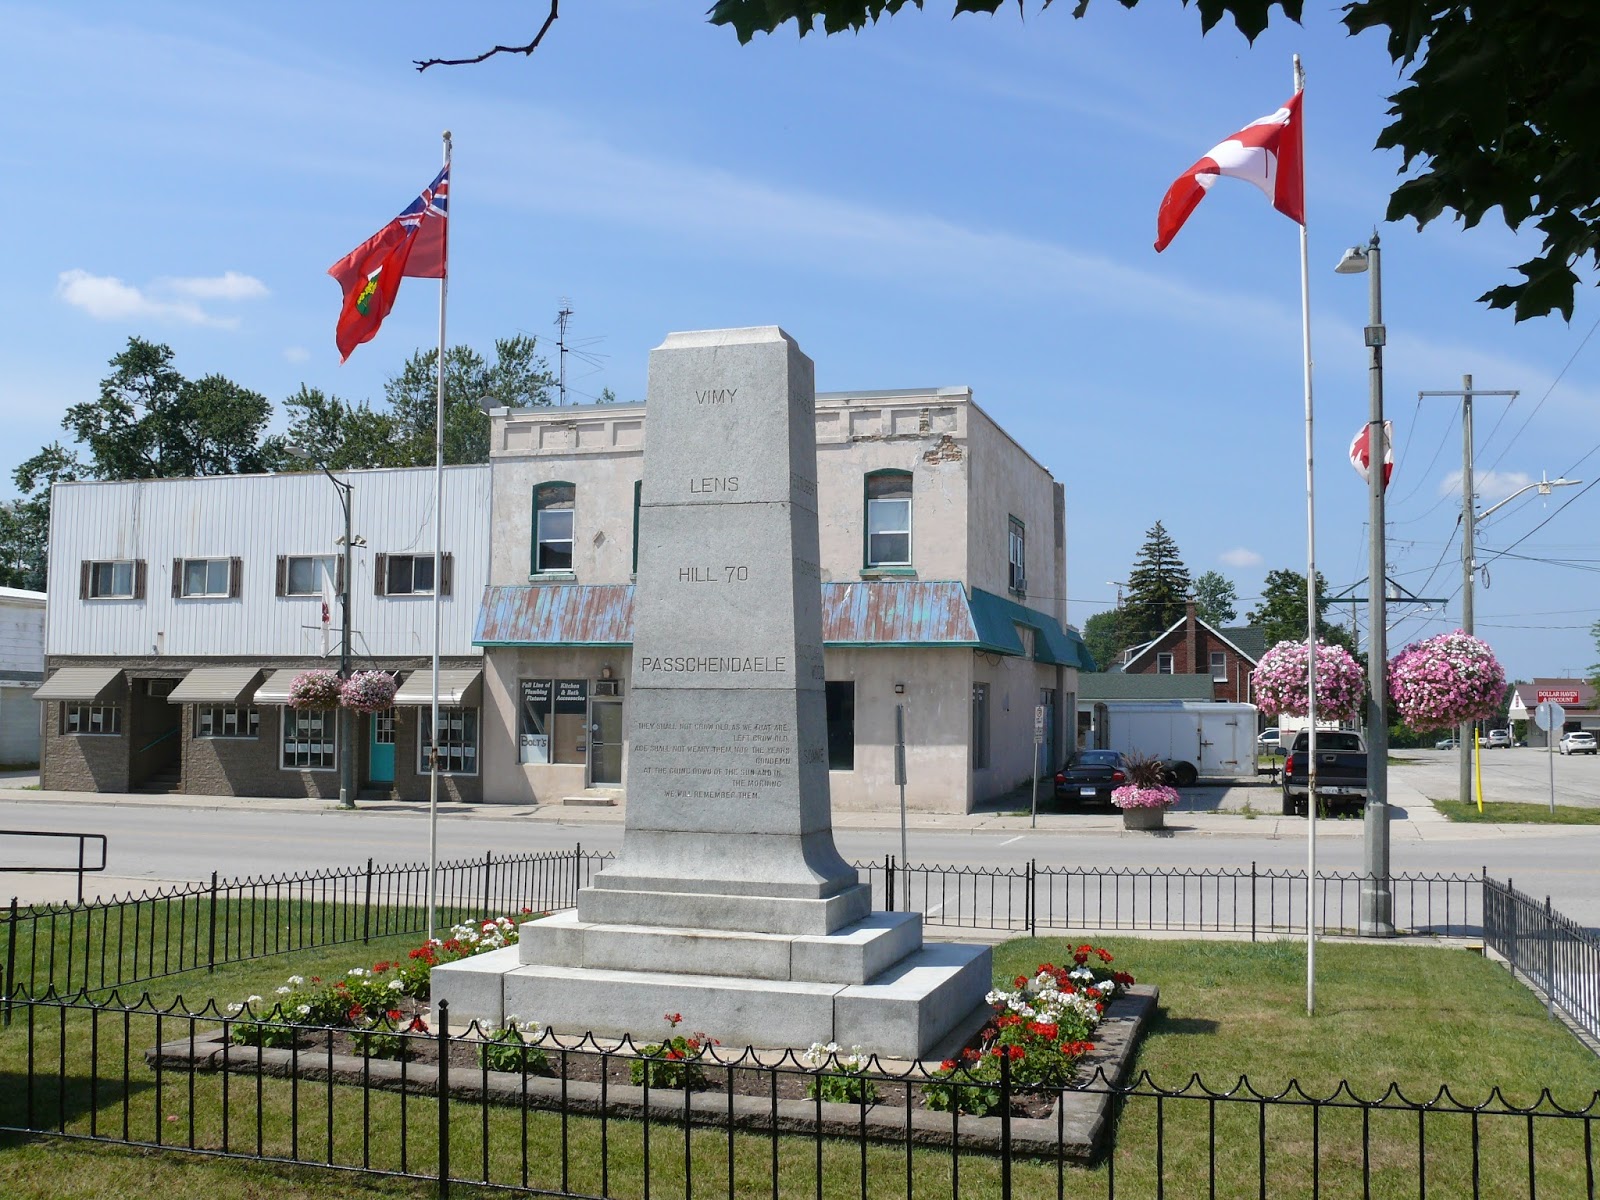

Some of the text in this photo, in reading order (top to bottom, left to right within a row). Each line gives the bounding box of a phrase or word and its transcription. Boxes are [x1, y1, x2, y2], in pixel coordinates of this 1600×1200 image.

[695, 388, 738, 405] VIMY
[690, 476, 739, 493] LENS
[678, 566, 749, 583] HILL 70
[641, 656, 786, 673] PASSCHENDAELE
[638, 722, 655, 730] THEY
[731, 723, 740, 731] AS
[743, 723, 752, 731] WE
[733, 734, 750, 742] LEFT
[687, 745, 710, 753] WEARY
[751, 746, 764, 754] THE
[755, 757, 791, 765] CONDEMN
[669, 767, 691, 775] GOING
[725, 768, 738, 776] THE
[740, 768, 755, 776] SUN
[732, 779, 782, 788] THE MORNING
[664, 790, 675, 798] WE
[693, 790, 736, 799] REMEMBER
